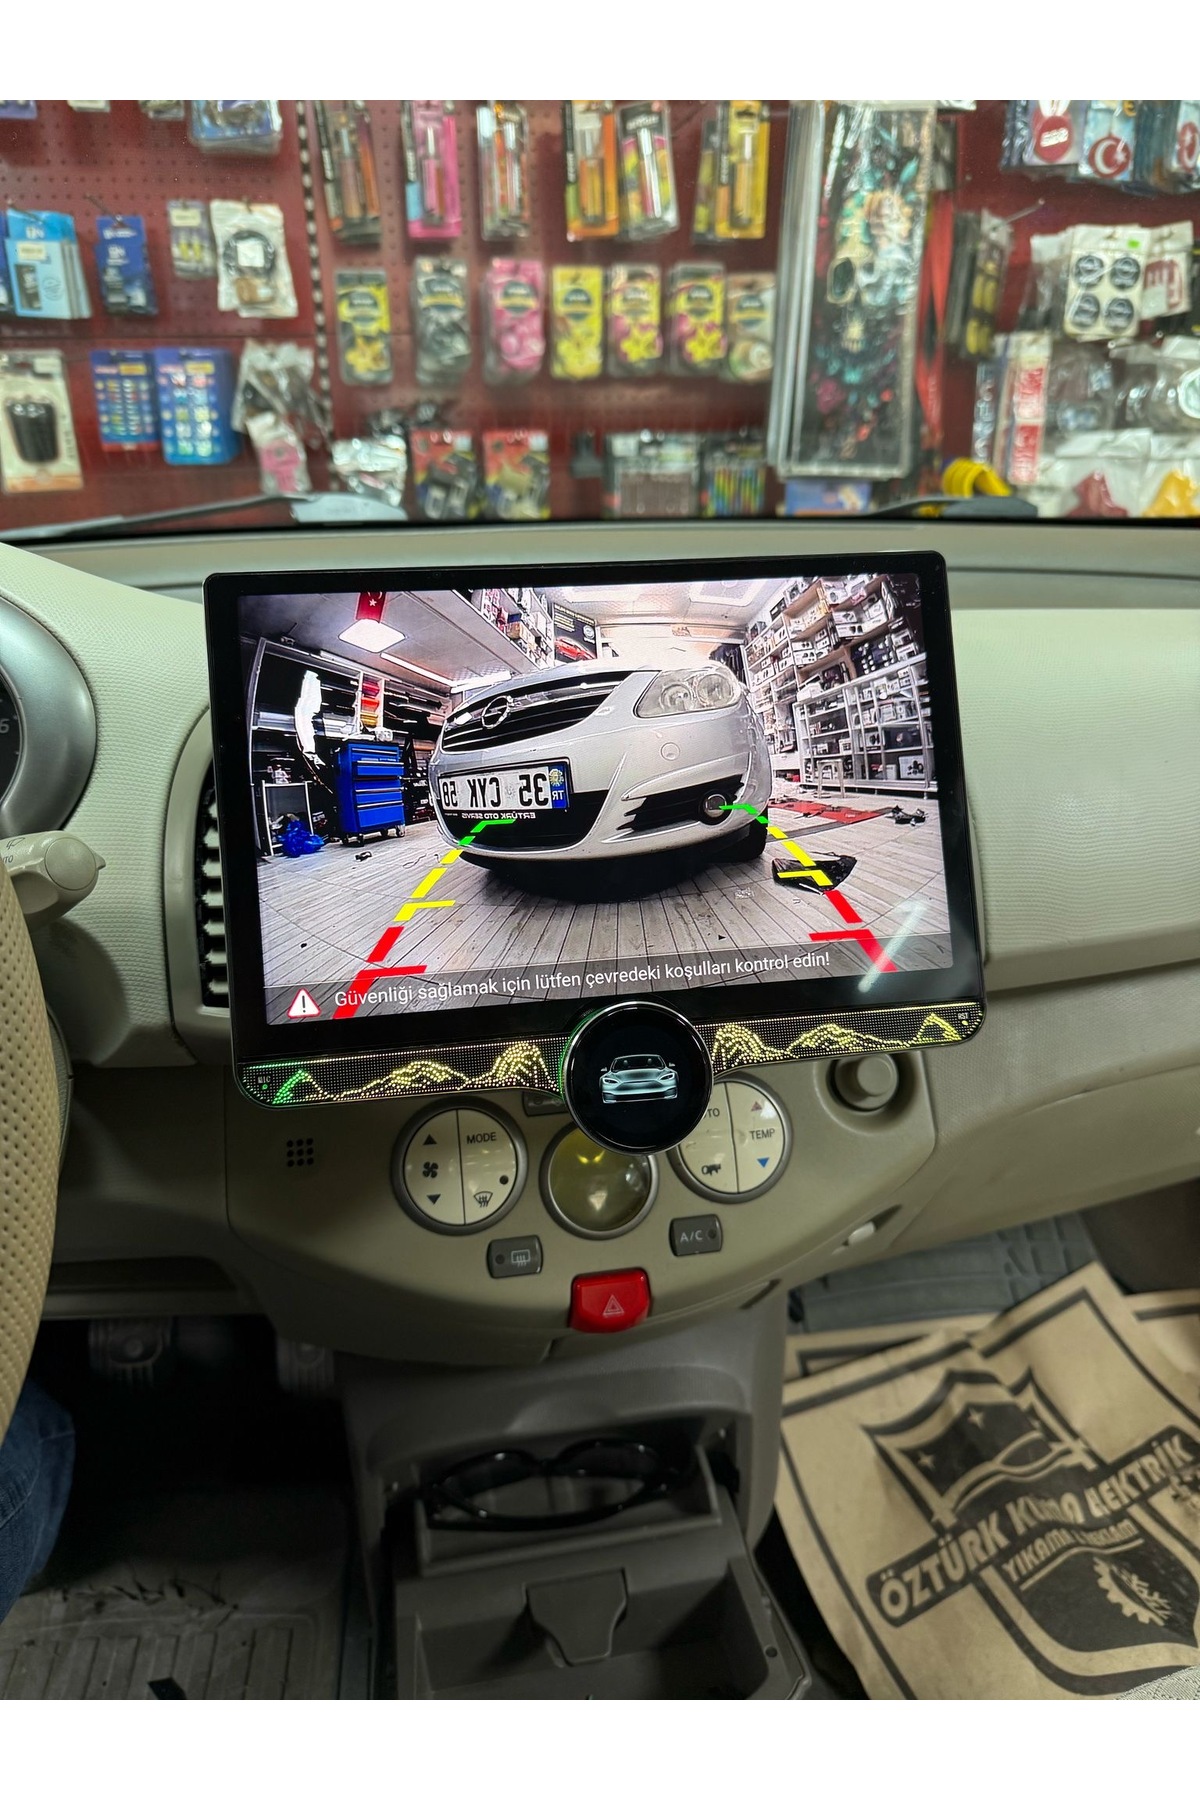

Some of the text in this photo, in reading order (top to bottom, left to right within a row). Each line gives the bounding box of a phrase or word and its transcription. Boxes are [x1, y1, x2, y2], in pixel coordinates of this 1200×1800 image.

[334, 951, 831, 1007] Güvenliği sağlamak için lütfen çevredeki koşulları kontrol edin!
[703, 1107, 721, 1119] TO
[466, 1131, 497, 1145] MODE
[749, 1127, 776, 1141] TEMP
[680, 1229, 703, 1244] A/C
[879, 1510, 1010, 1619] ÖZTÜRK
